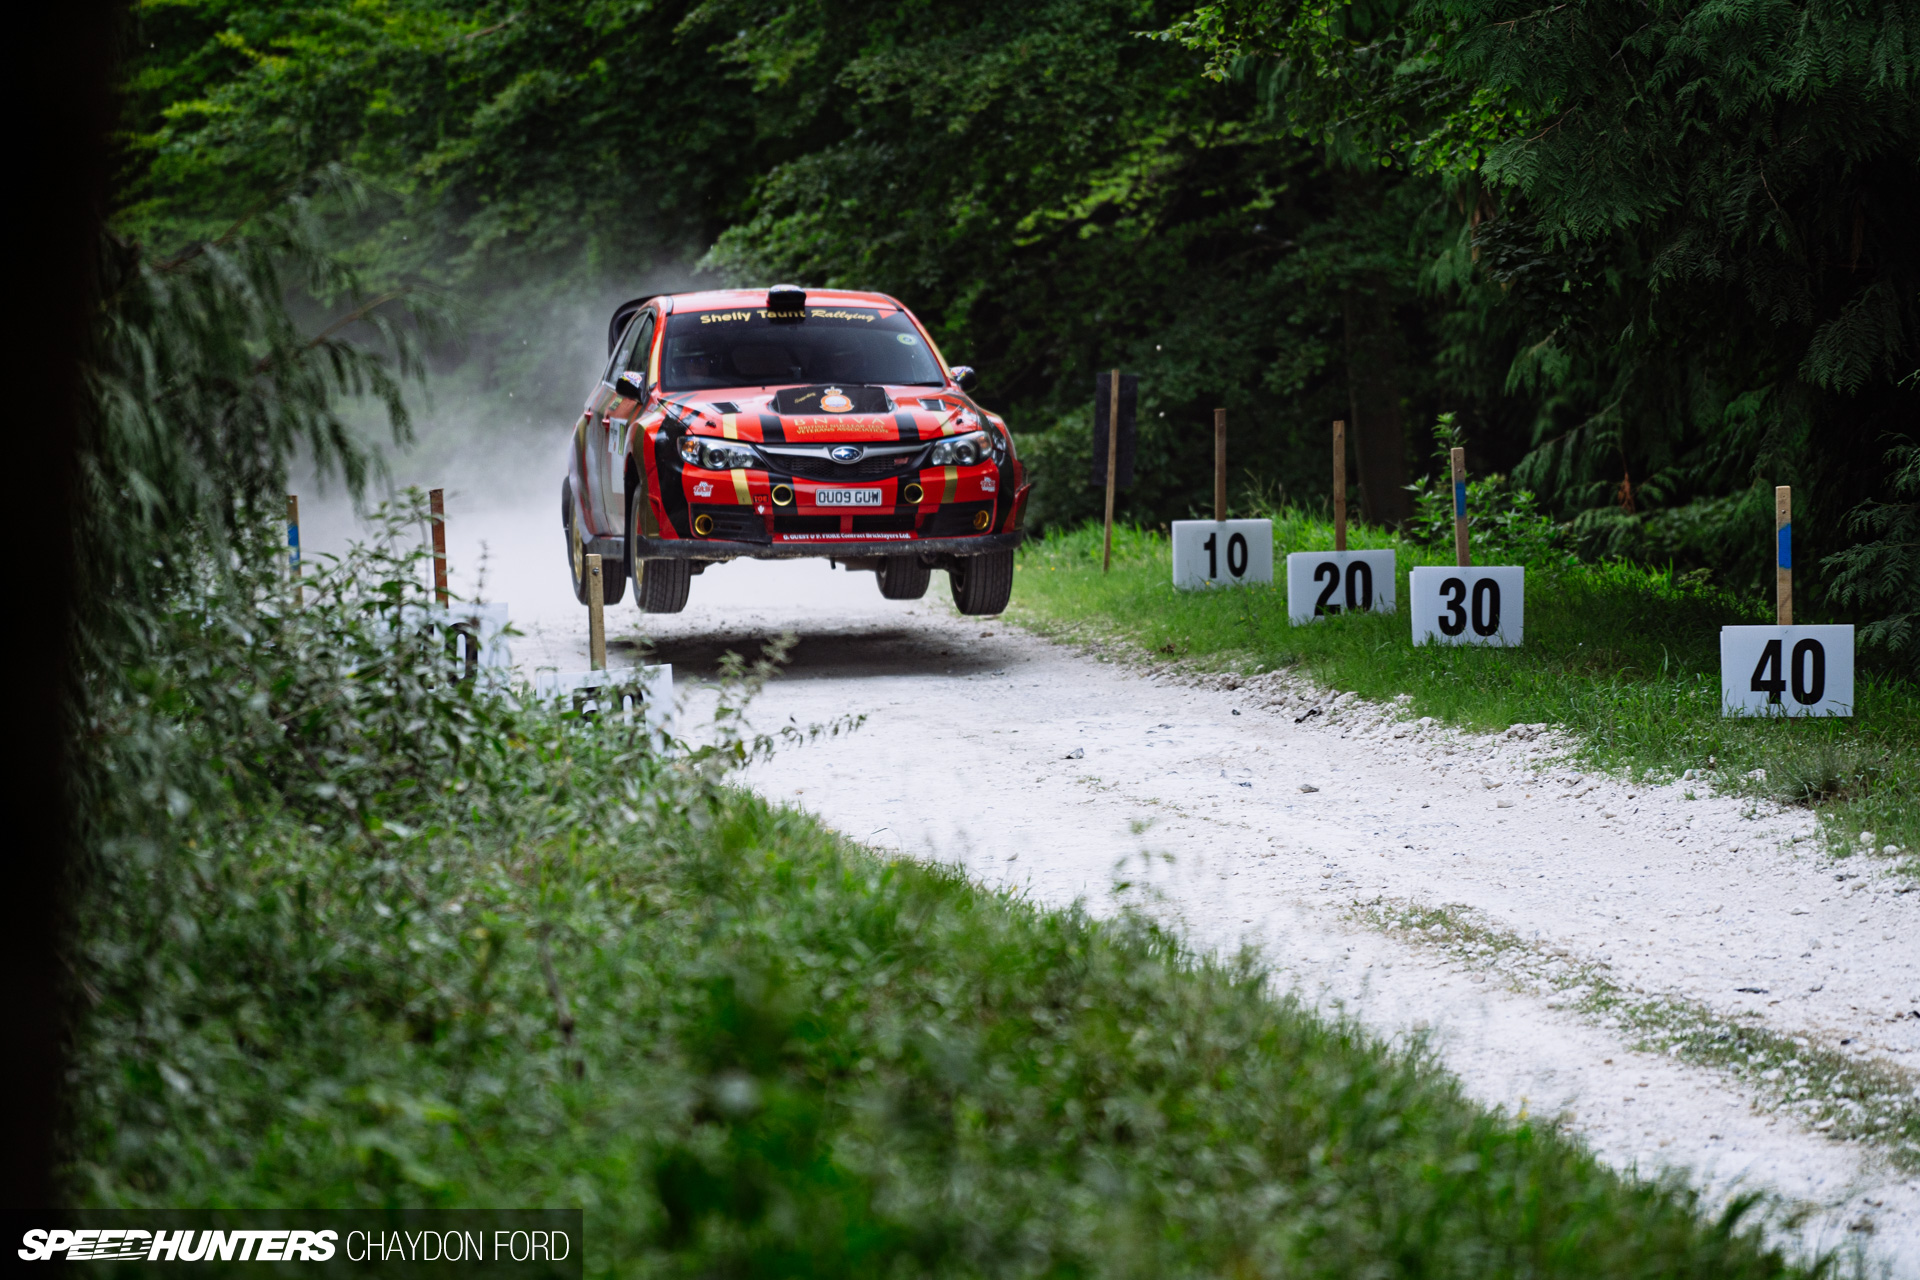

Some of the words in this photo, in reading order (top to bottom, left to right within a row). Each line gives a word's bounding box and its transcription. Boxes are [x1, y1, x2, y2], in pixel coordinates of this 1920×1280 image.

[700, 311, 751, 324] Shelly
[757, 310, 806, 319] Taunt
[811, 309, 876, 322] Rallying
[818, 491, 851, 503] OU09
[854, 491, 879, 503] GUW
[865, 532, 898, 540] Bricklayers
[1203, 532, 1248, 579] 10
[1313, 560, 1373, 617] 20
[1438, 577, 1501, 637] 30
[1750, 638, 1826, 706] 40
